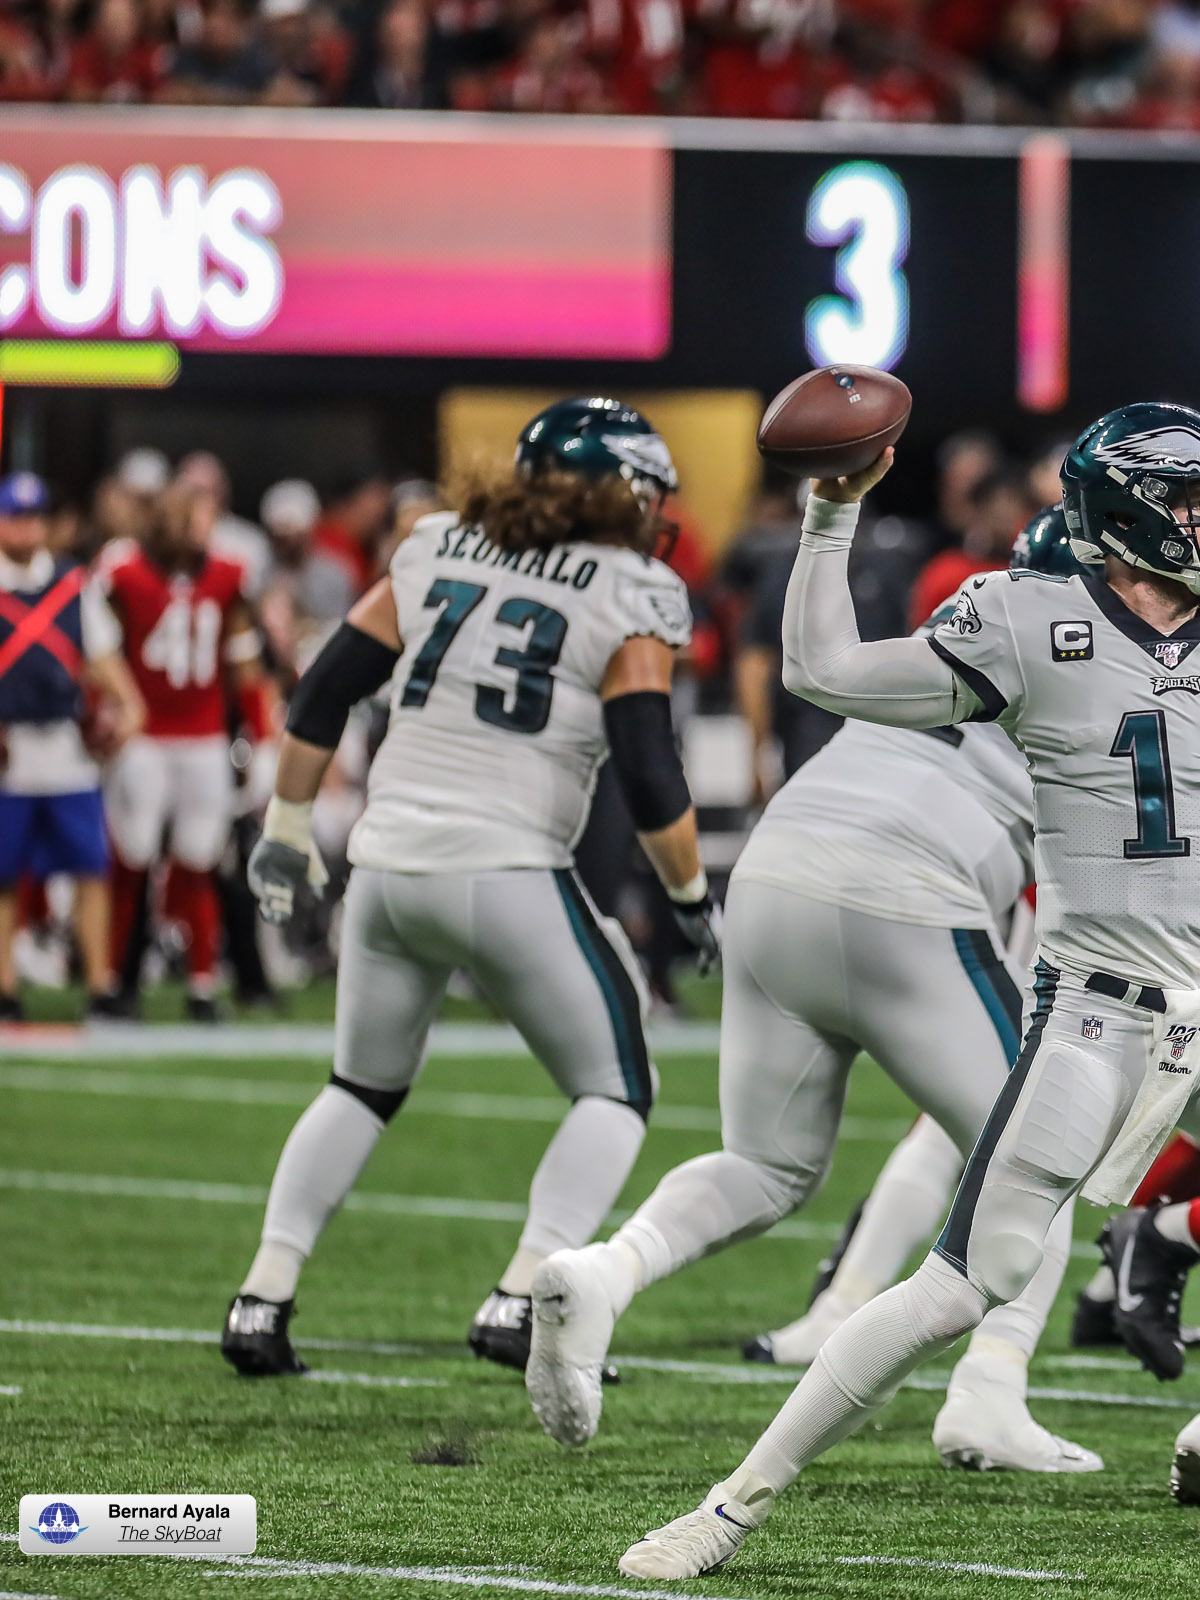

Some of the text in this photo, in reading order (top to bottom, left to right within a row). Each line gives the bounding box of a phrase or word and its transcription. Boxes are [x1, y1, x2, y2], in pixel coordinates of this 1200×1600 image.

[806, 162, 910, 371] 3
[142, 597, 222, 690] 41
[401, 579, 568, 734] 73
[1054, 623, 1091, 651] C
[1083, 1026, 1100, 1038] NFL
[1158, 1061, 1189, 1075] Wilson
